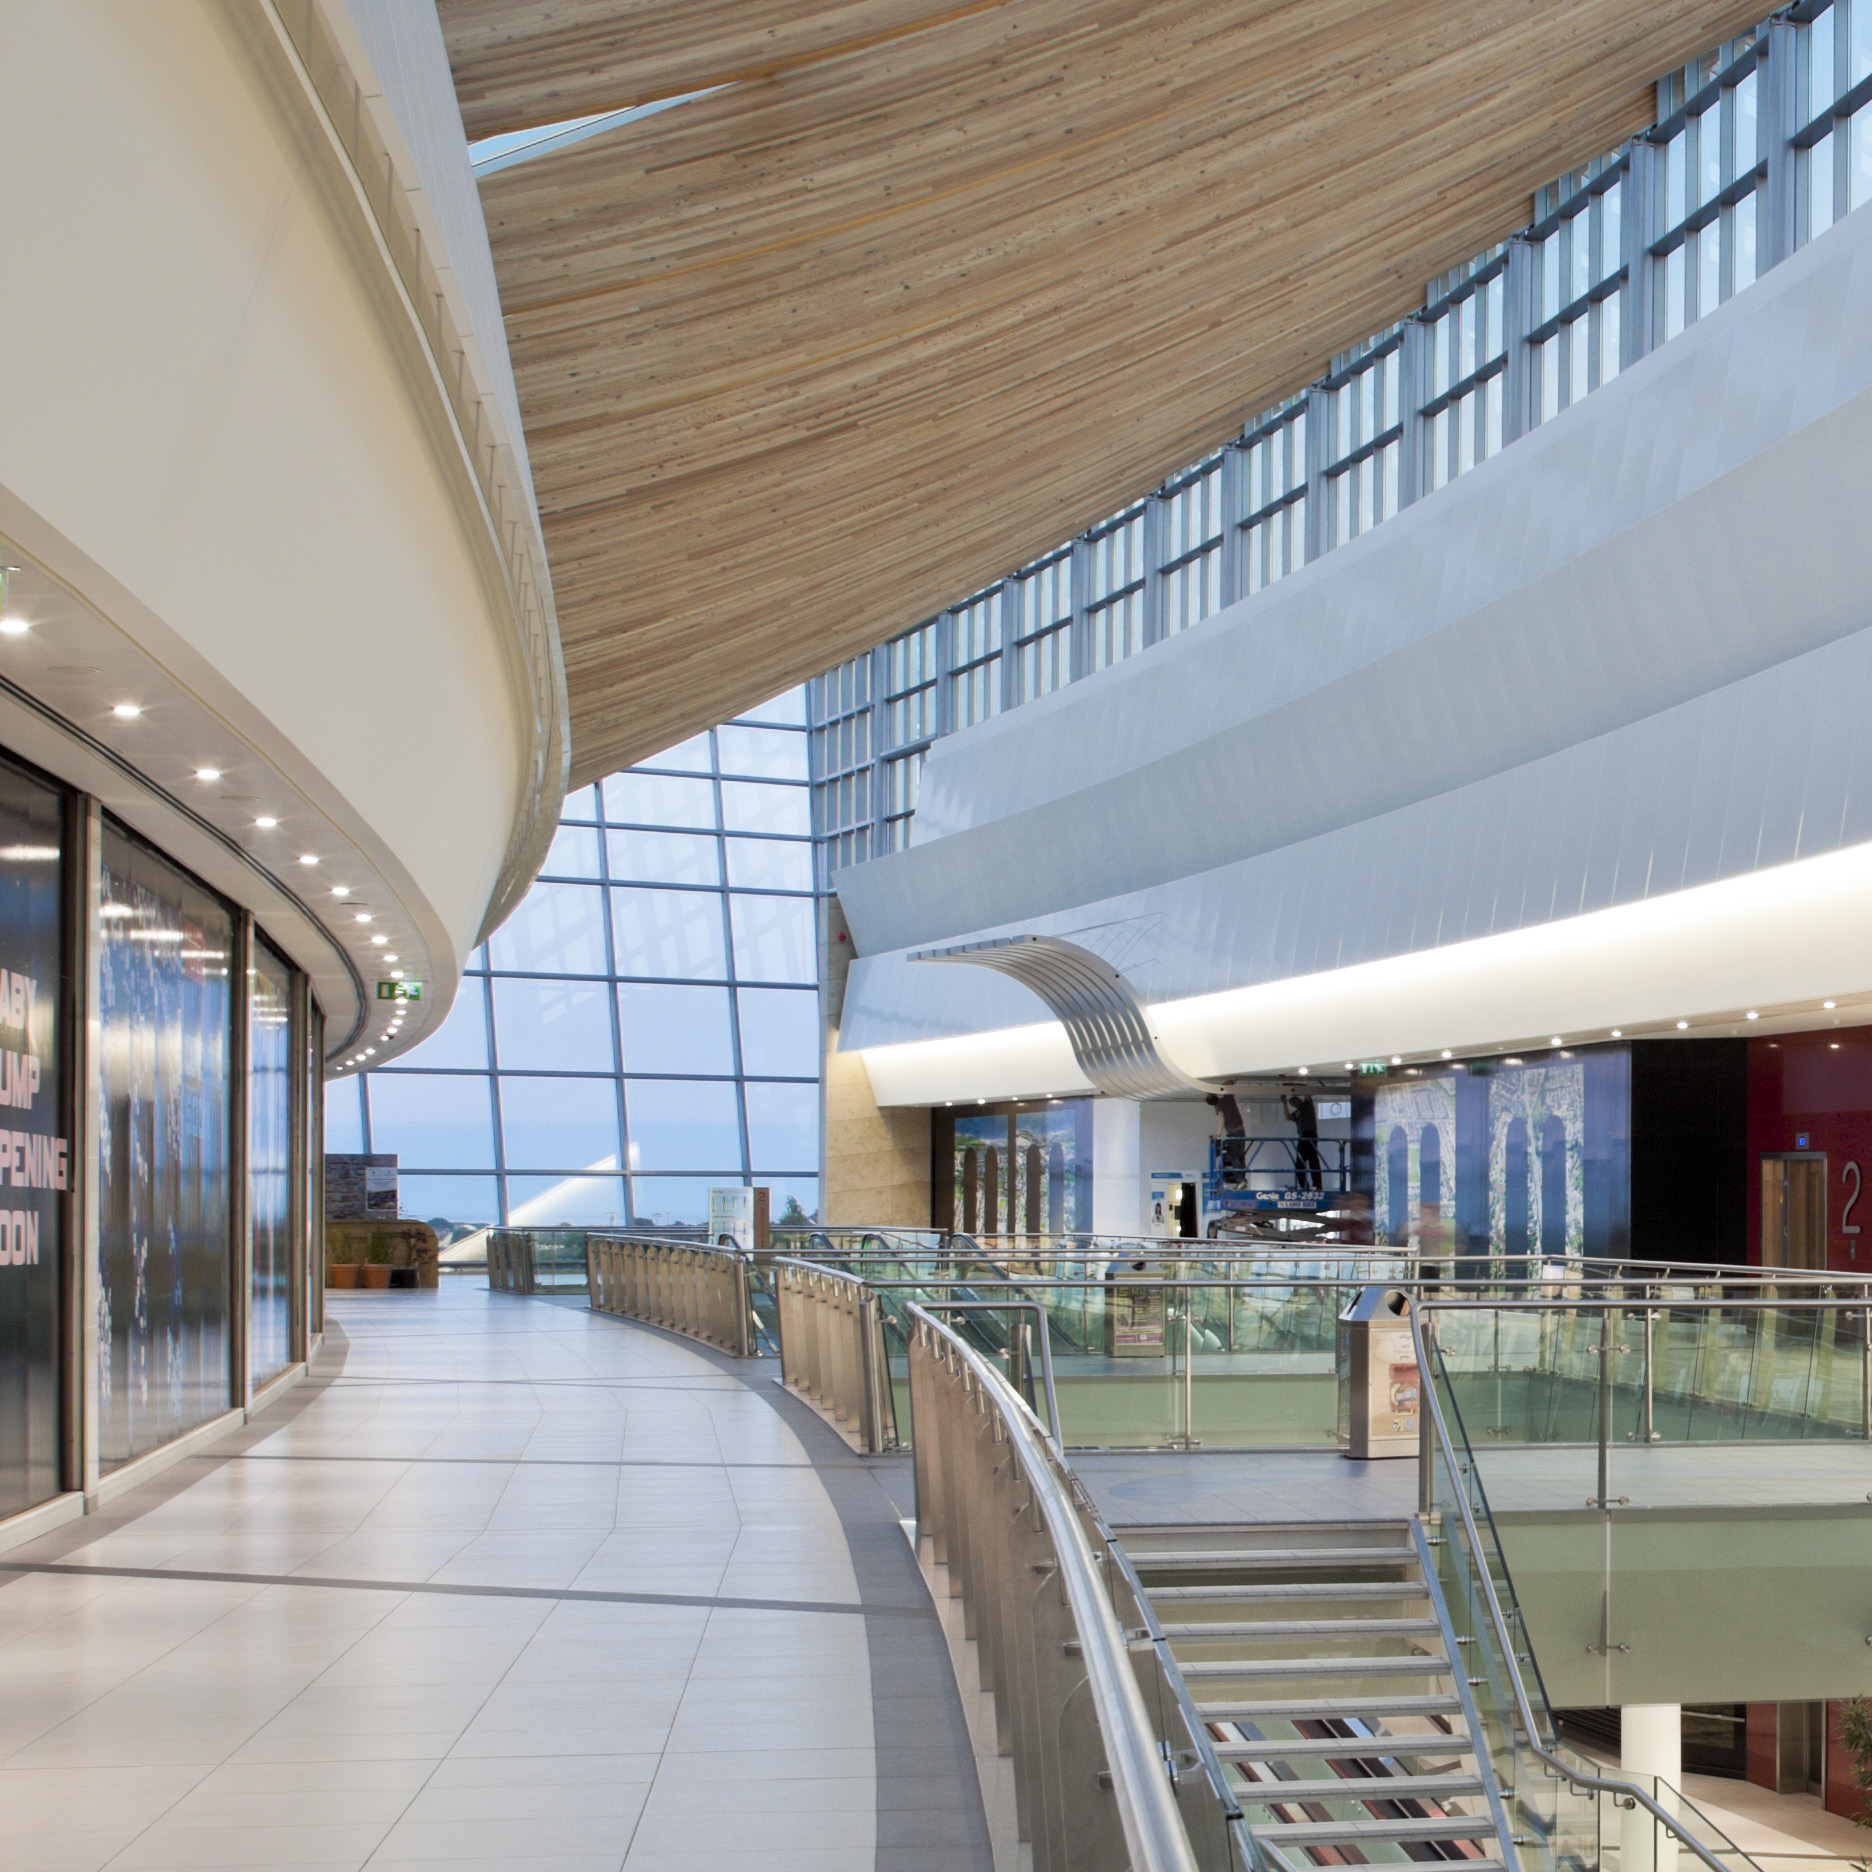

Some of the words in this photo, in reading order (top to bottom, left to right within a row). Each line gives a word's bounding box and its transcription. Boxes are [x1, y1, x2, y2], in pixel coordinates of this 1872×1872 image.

[0, 967, 37, 1031] ABY
[0, 1049, 40, 1109] UMP
[0, 1129, 68, 1190] PENING
[1842, 1161, 1860, 1233] 2
[0, 1209, 39, 1265] OON
